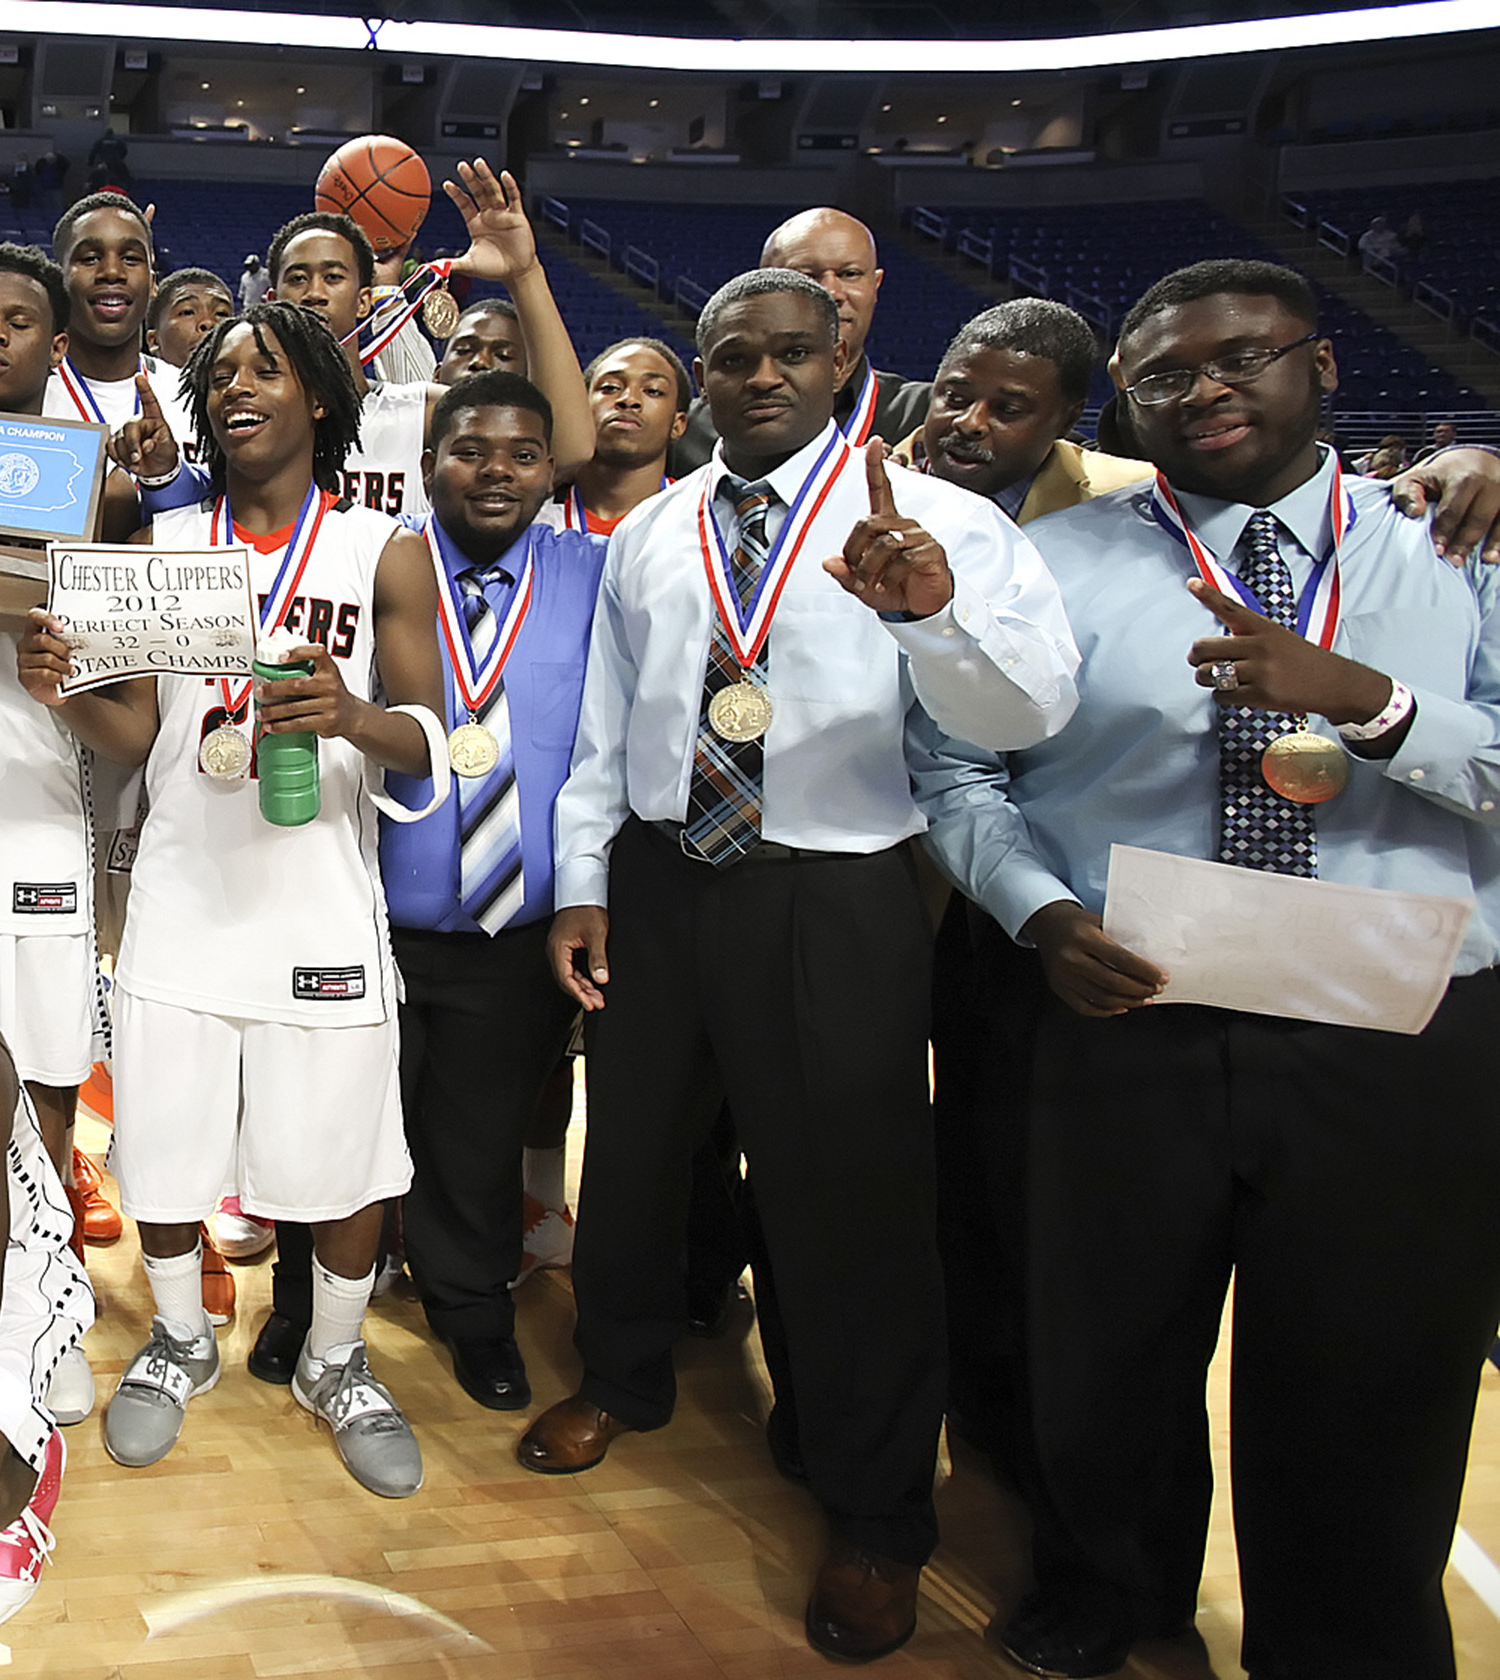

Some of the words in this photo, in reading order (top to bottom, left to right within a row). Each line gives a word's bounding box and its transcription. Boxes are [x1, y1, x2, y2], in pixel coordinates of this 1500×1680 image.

[7, 426, 66, 442] CHAMPION
[59, 554, 139, 592] CHESTER
[146, 557, 244, 592] CLIPPERS
[106, 594, 183, 613] 2012
[57, 613, 151, 634] PERFECT
[159, 612, 246, 631] SEASON
[111, 635, 140, 650] 32
[176, 634, 190, 647] 0
[69, 655, 139, 679] STATE
[146, 650, 249, 670] CHAMPS
